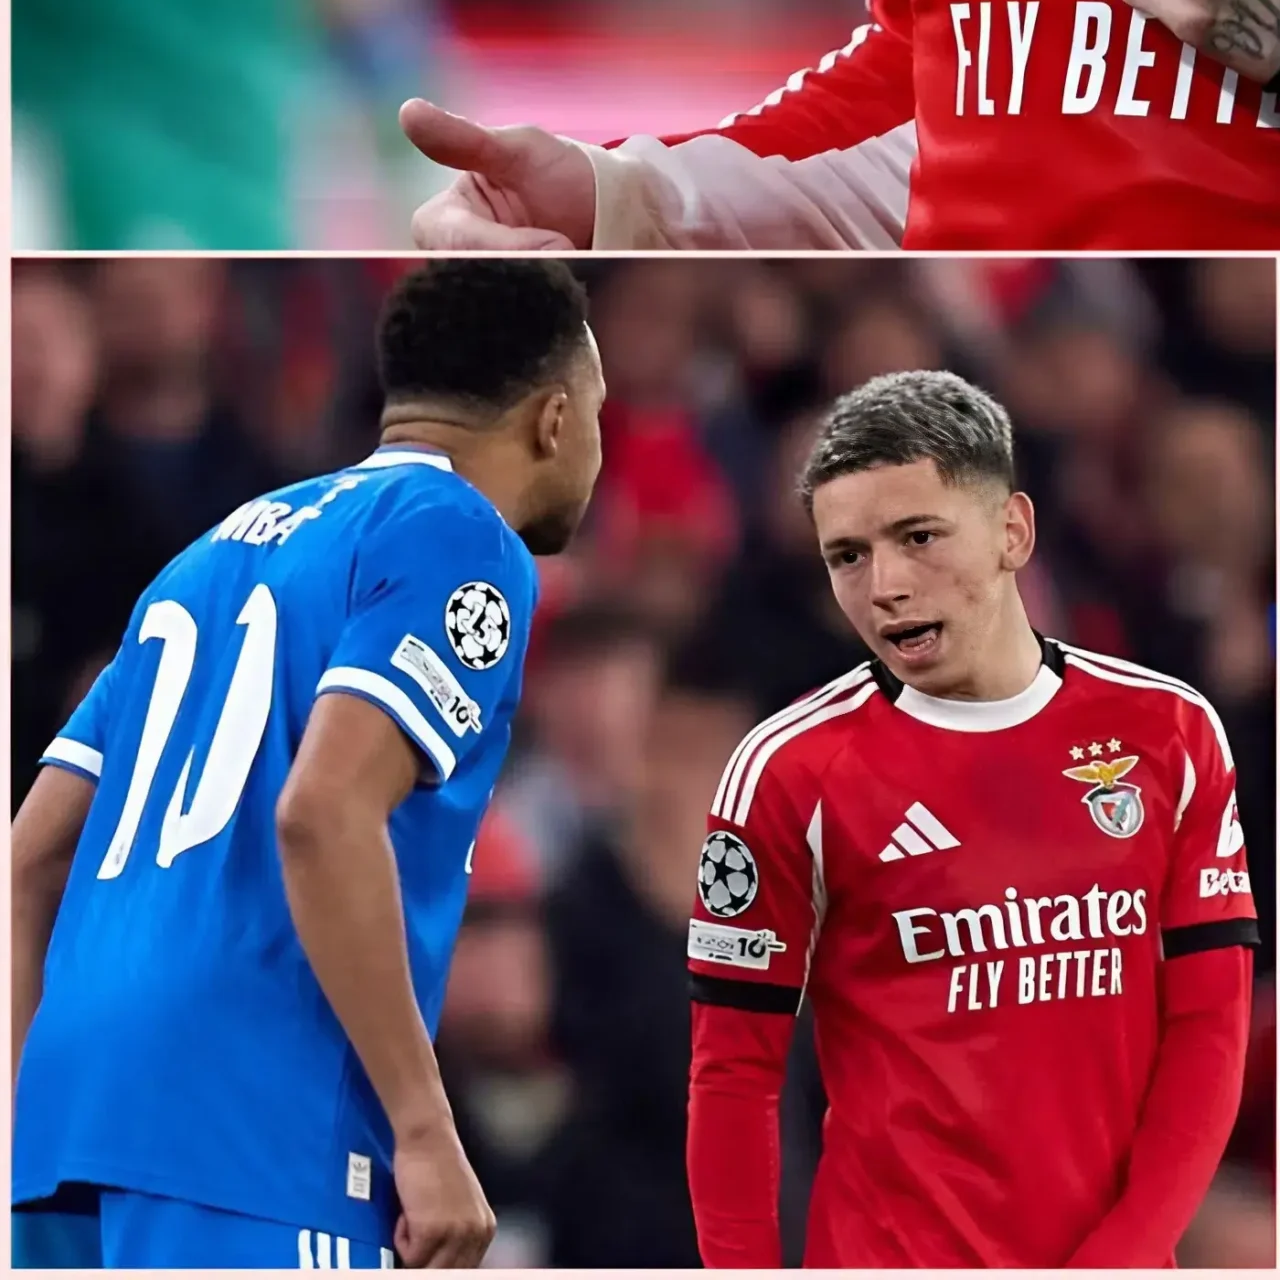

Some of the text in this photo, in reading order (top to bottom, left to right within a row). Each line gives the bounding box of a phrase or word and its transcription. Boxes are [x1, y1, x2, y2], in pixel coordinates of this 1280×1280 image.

[950, 1, 1040, 117] FLY
[891, 883, 1147, 963] Emirates
[947, 947, 1123, 1013] FLY BETTER
